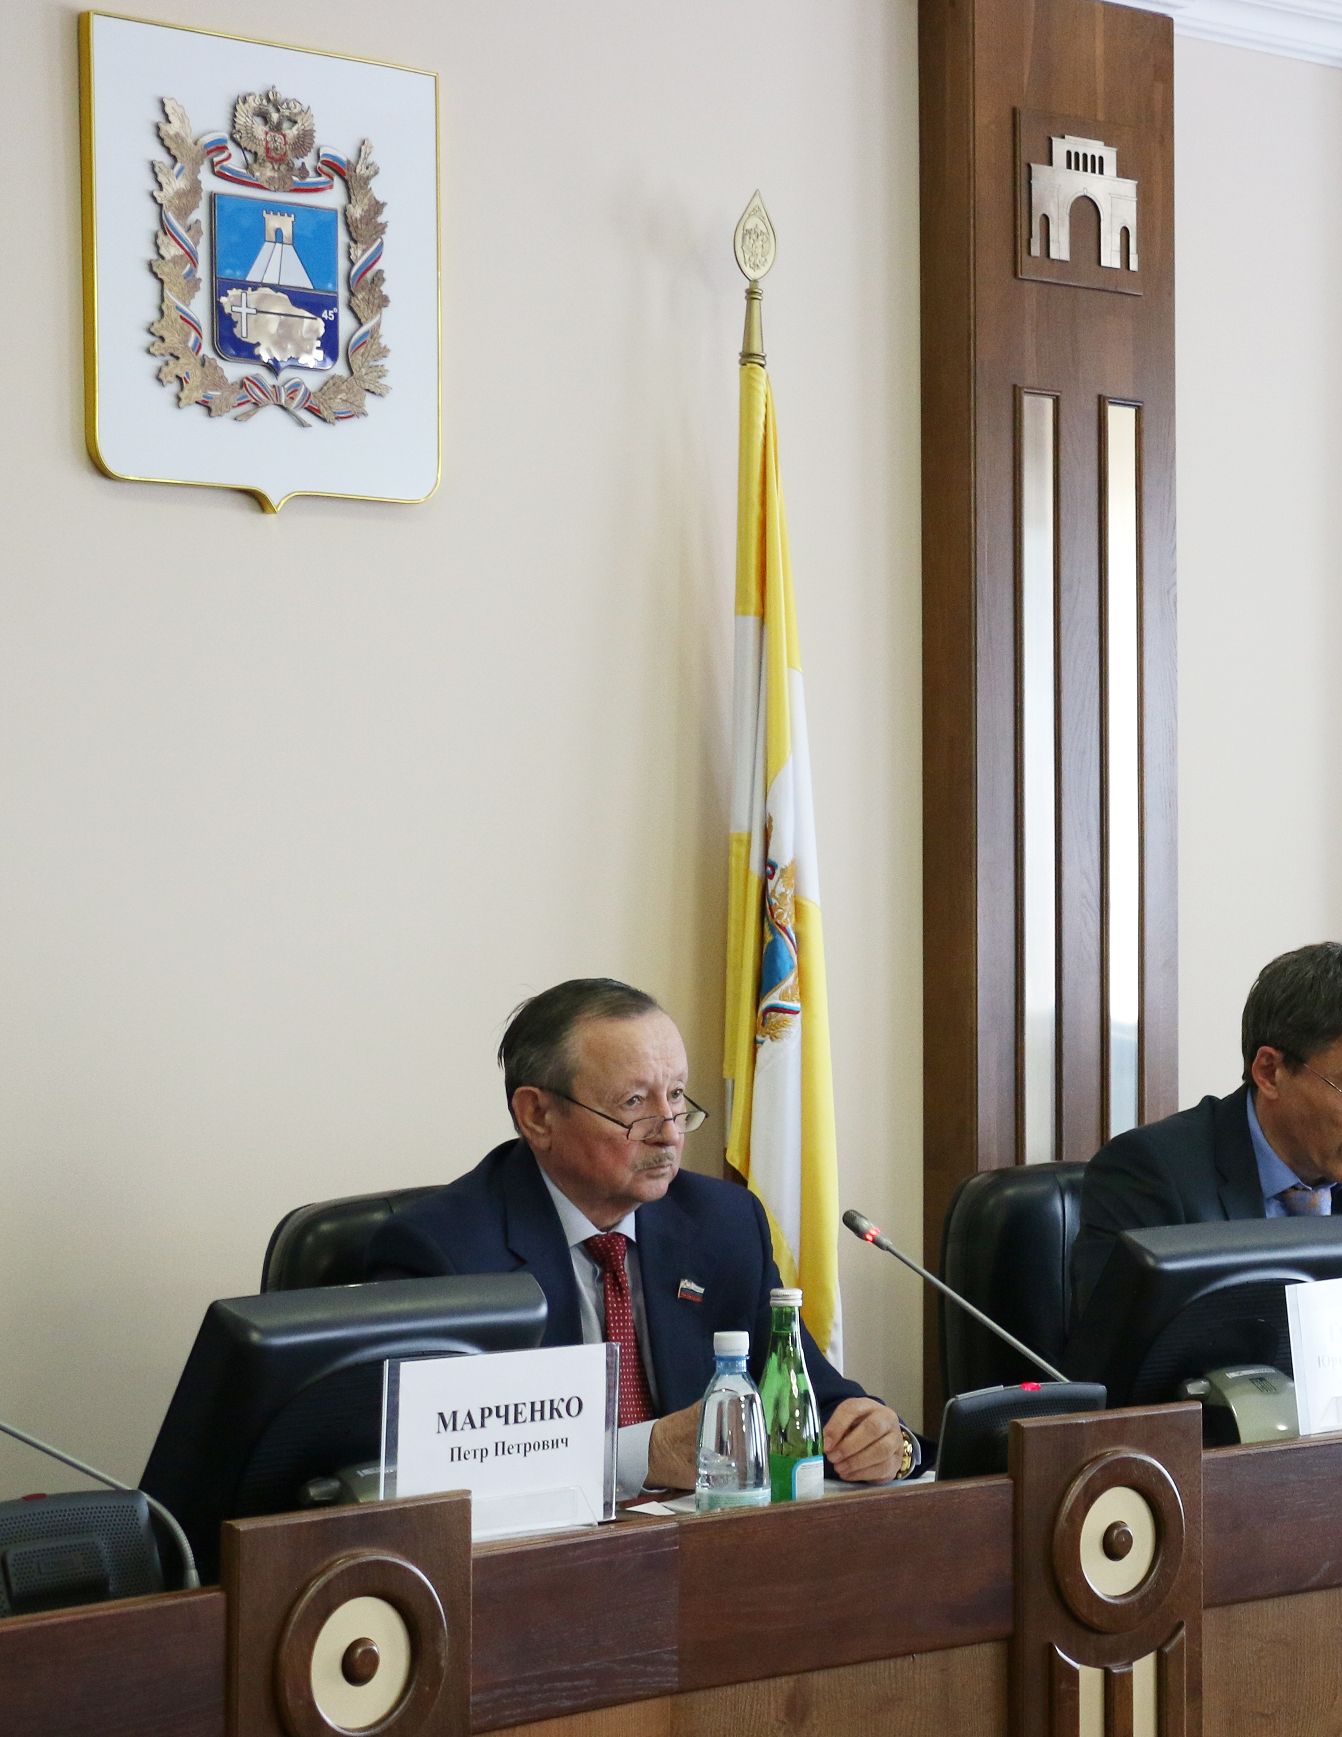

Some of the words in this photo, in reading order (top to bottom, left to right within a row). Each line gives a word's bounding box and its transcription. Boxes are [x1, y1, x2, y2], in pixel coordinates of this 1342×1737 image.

[436, 1395, 584, 1434] МАРЧЕНКО
[450, 1446, 489, 1463] Петр
[494, 1437, 569, 1458] Петрович
